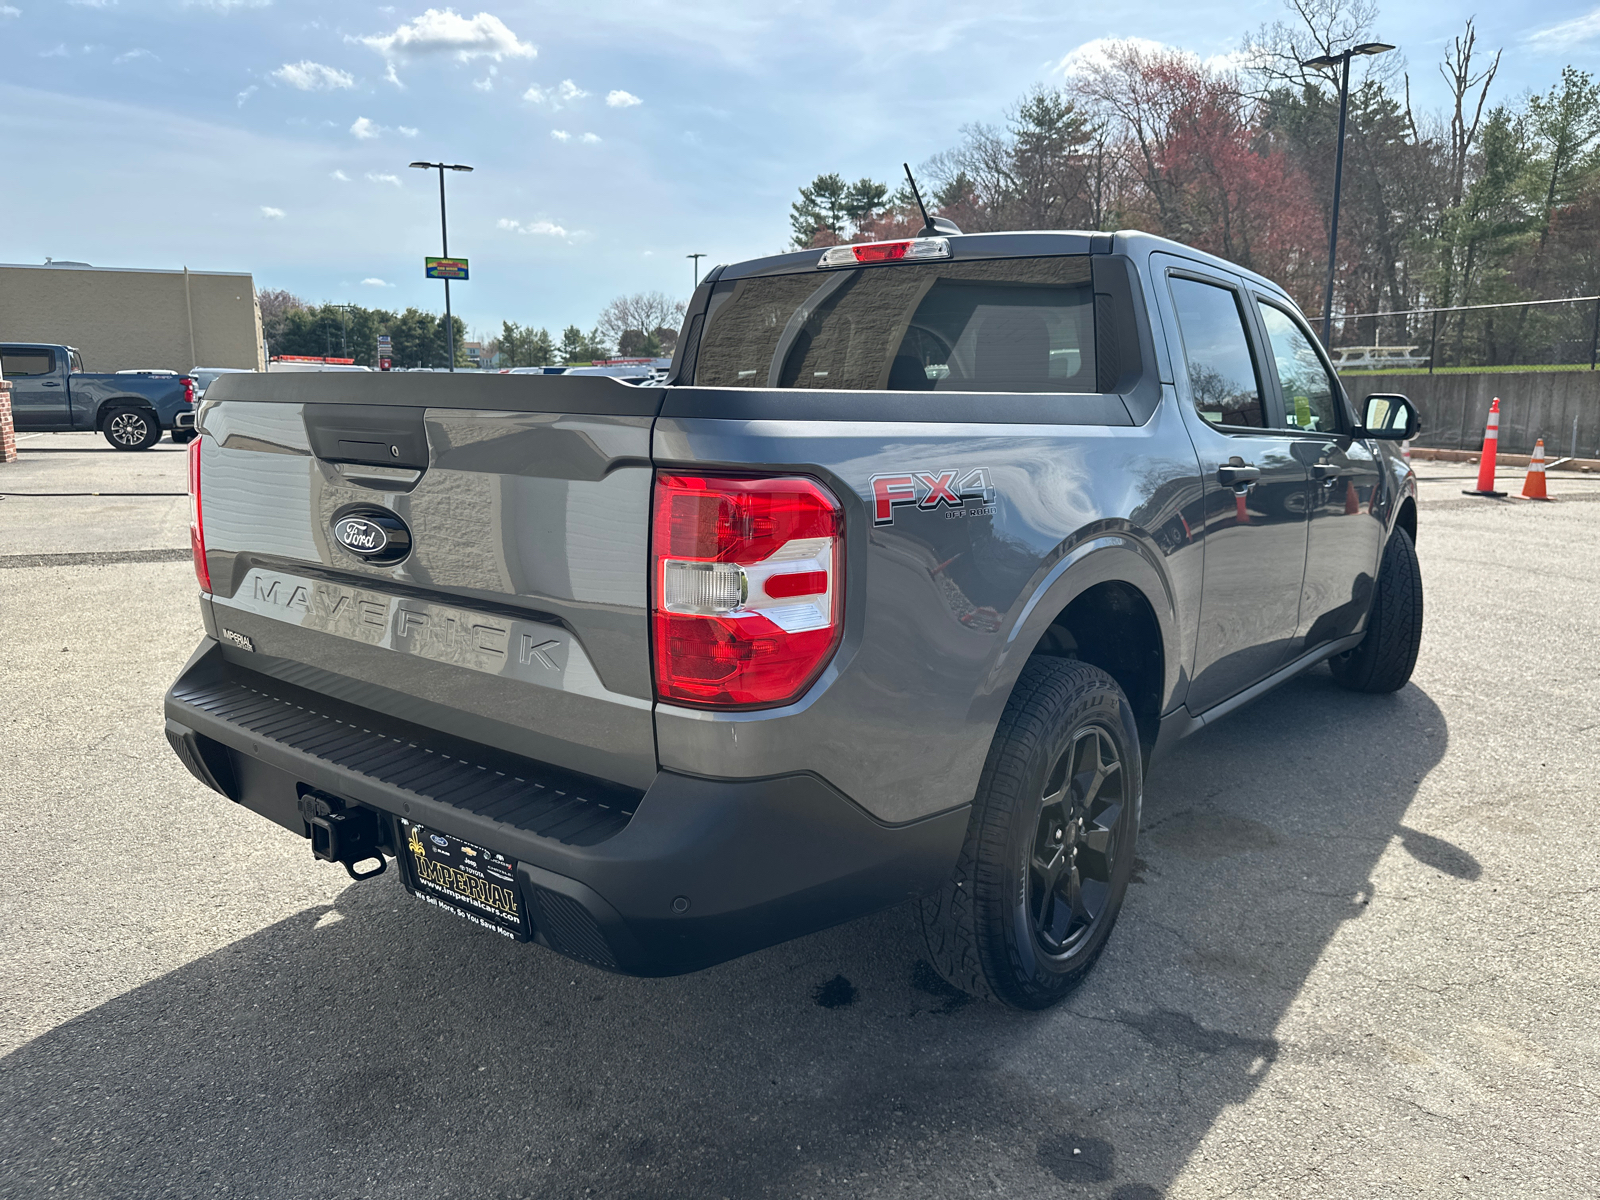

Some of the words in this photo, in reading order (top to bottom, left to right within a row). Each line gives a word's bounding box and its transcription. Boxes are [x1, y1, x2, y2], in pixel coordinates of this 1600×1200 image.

[868, 467, 996, 527] FX4
[945, 511, 966, 519] OFF
[970, 507, 997, 517] ROAD
[344, 522, 376, 547] Ford
[254, 576, 561, 671] MAVERICK
[414, 854, 519, 916] IMPERIAL
[465, 866, 485, 878] TOYOTA
[415, 891, 426, 901] We
[426, 895, 438, 906] Sell
[456, 908, 466, 917] So
[466, 912, 479, 924] You
[480, 919, 496, 932] Save
[497, 926, 514, 939] More
